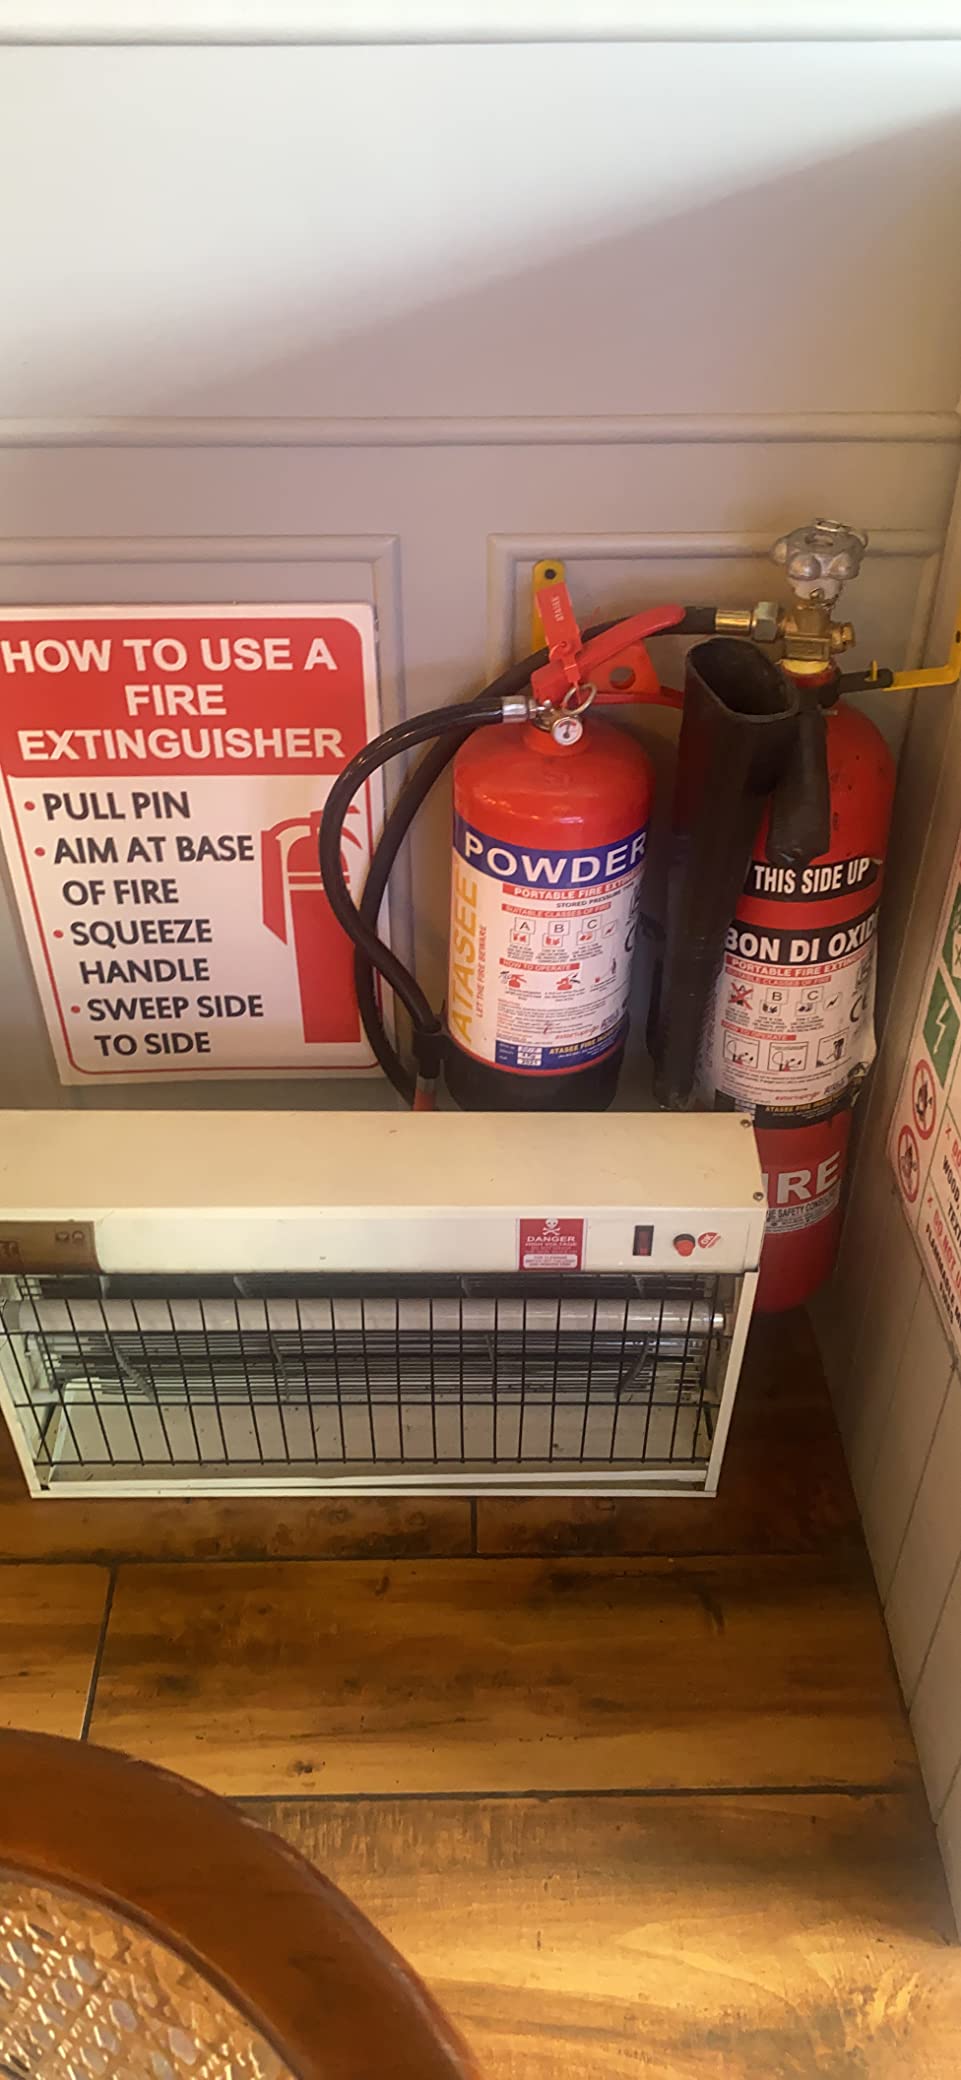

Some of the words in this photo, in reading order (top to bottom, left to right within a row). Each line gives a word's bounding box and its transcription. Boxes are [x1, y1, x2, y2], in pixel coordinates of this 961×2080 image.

[2, 639, 111, 673] HOW
[123, 638, 188, 672] TO
[199, 637, 295, 671] USE
[304, 637, 339, 671] A
[124, 684, 228, 716] FIRE
[16, 727, 346, 761] EXTINGUISHER
[42, 792, 126, 821] PULL
[132, 791, 191, 820] PIN
[53, 836, 119, 864] AIM
[126, 836, 167, 864] AT
[175, 834, 255, 863] BASE
[465, 832, 647, 884] POWDER
[754, 865, 796, 894] THIS
[801, 864, 844, 894] SIDE
[847, 857, 870, 885] UP
[62, 880, 106, 906] OF
[114, 879, 179, 904] FIRE
[514, 887, 575, 900] PORTABLE
[578, 885, 603, 898] FIRE
[556, 900, 588, 909] STORED
[69, 918, 213, 948] SQUEEZE
[519, 919, 531, 931] A
[554, 924, 565, 934] B
[587, 919, 598, 930] C
[451, 865, 477, 1043] ATASEE
[478, 924, 487, 962] BEWARE
[790, 937, 821, 963] DI
[79, 958, 210, 985] HANDLE
[478, 963, 486, 983] FIRE
[732, 958, 792, 977] PORTABLE
[795, 966, 821, 977] FIRE
[477, 984, 485, 1000] THE
[772, 992, 782, 1001] B
[807, 990, 819, 1000] C
[86, 996, 189, 1021] SWEEP
[197, 994, 265, 1019] SIDE
[476, 1002, 484, 1018] LET
[94, 1034, 138, 1057] TO
[143, 1031, 212, 1055] SIDE
[778, 1206, 804, 1218] SAFETY
